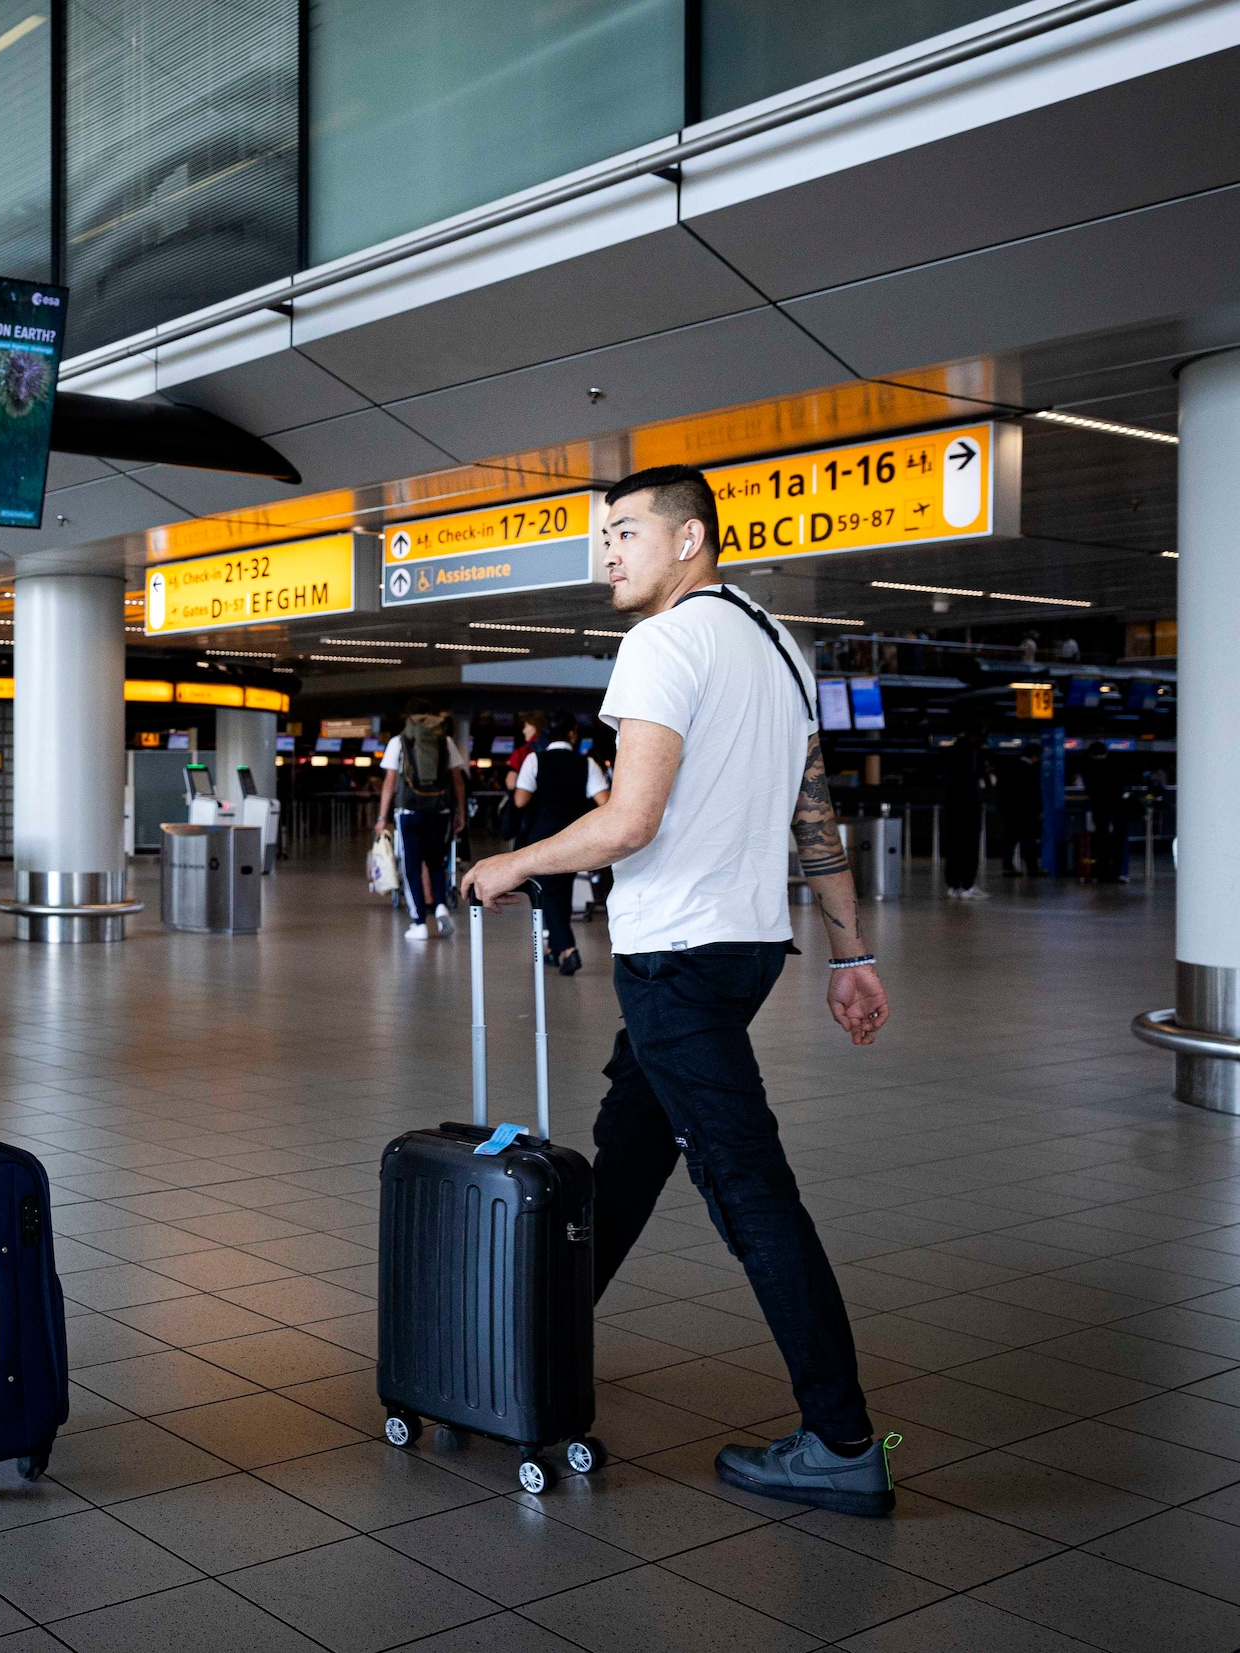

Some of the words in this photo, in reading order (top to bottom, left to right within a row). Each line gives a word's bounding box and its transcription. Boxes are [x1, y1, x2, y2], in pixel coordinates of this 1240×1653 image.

[42, 296, 60, 307] esa
[14, 326, 56, 343] EARTH?
[713, 480, 761, 500] ck-in
[769, 470, 805, 499] 1a
[824, 451, 895, 491] 1-16
[438, 524, 494, 544] Check-in
[499, 506, 567, 540] 17-20
[837, 508, 895, 532] 59-87
[182, 568, 222, 585] Check-in
[225, 556, 270, 583] 21-32
[435, 563, 511, 585] Assistance
[182, 605, 208, 618] Gates
[212, 599, 222, 619] D
